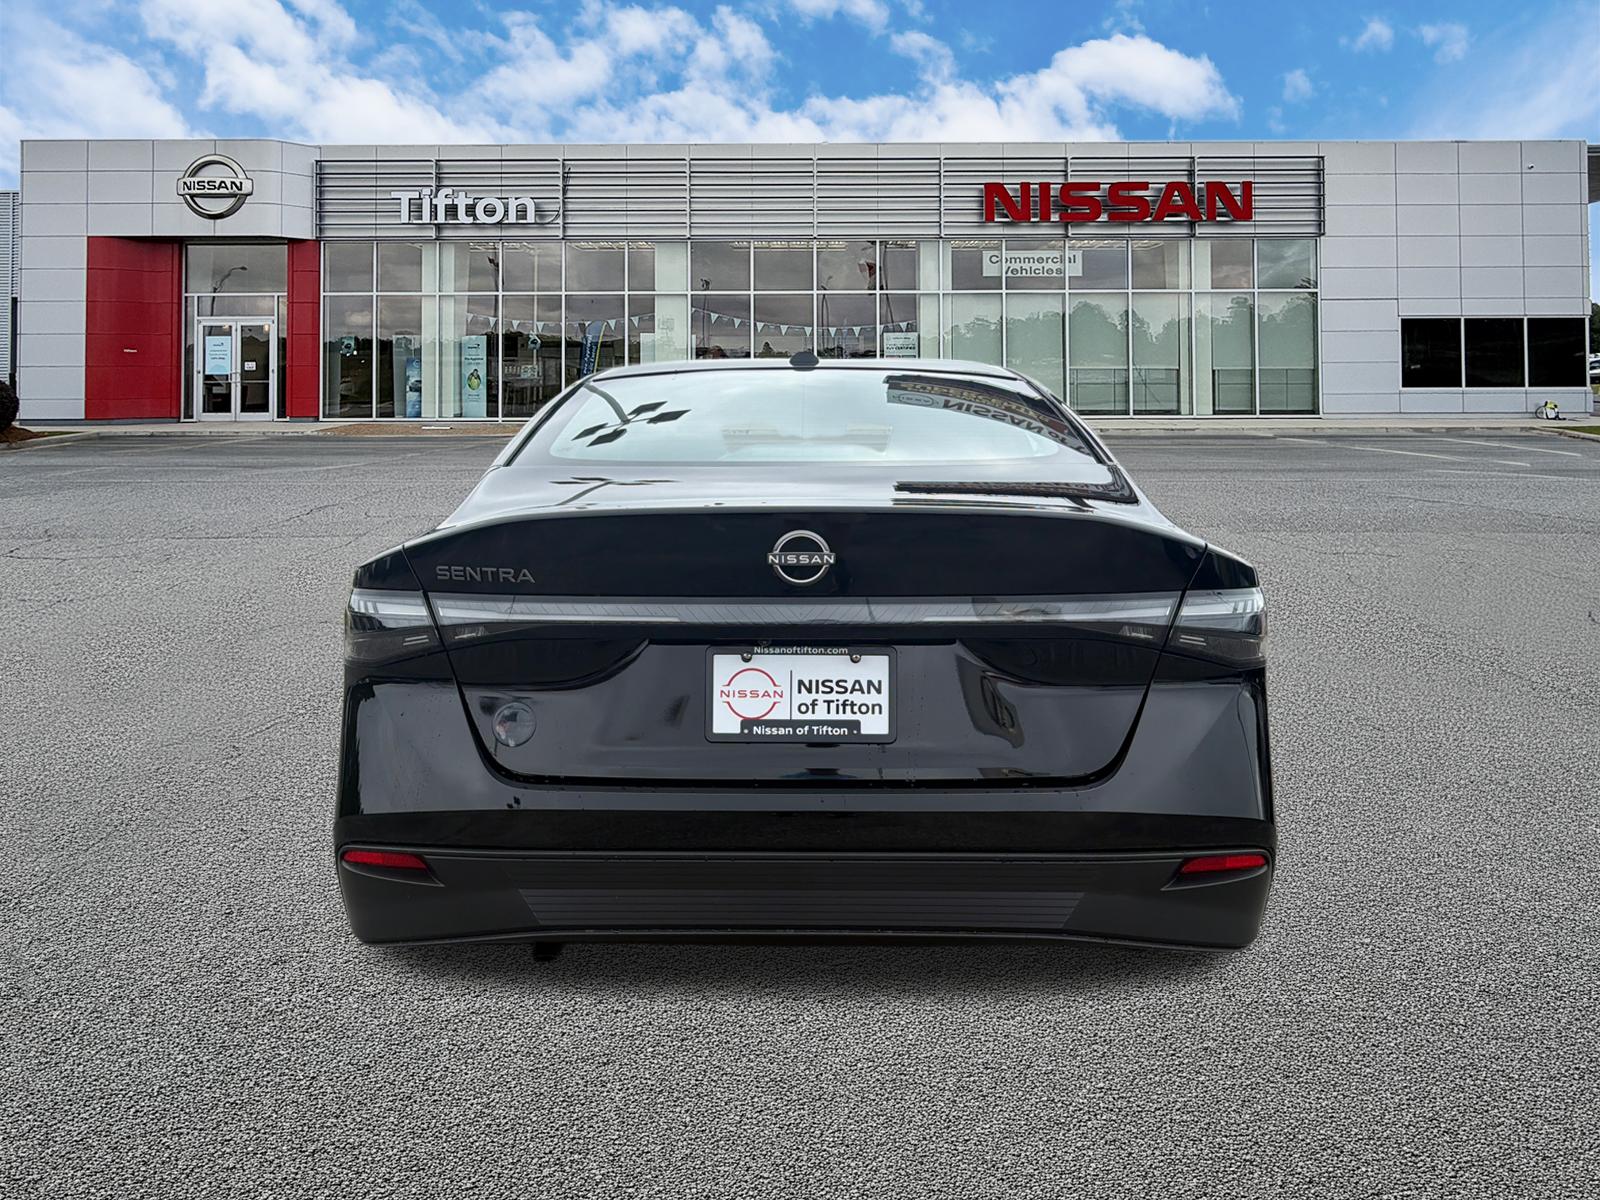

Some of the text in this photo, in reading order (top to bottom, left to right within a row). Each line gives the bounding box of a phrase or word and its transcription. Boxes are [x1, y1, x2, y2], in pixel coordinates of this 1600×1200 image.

[182, 180, 243, 192] NISSAN
[391, 188, 536, 225] Tifton
[983, 180, 1254, 222] NISSAN
[768, 554, 835, 564] NISSAN
[436, 565, 536, 583] SENTRA
[754, 646, 848, 655] Nissanoftifton.com
[720, 689, 784, 698] NISSAN
[797, 679, 882, 695] NISSAN
[797, 699, 883, 715] of Tifton
[753, 725, 848, 735] Nissan of Tifton
